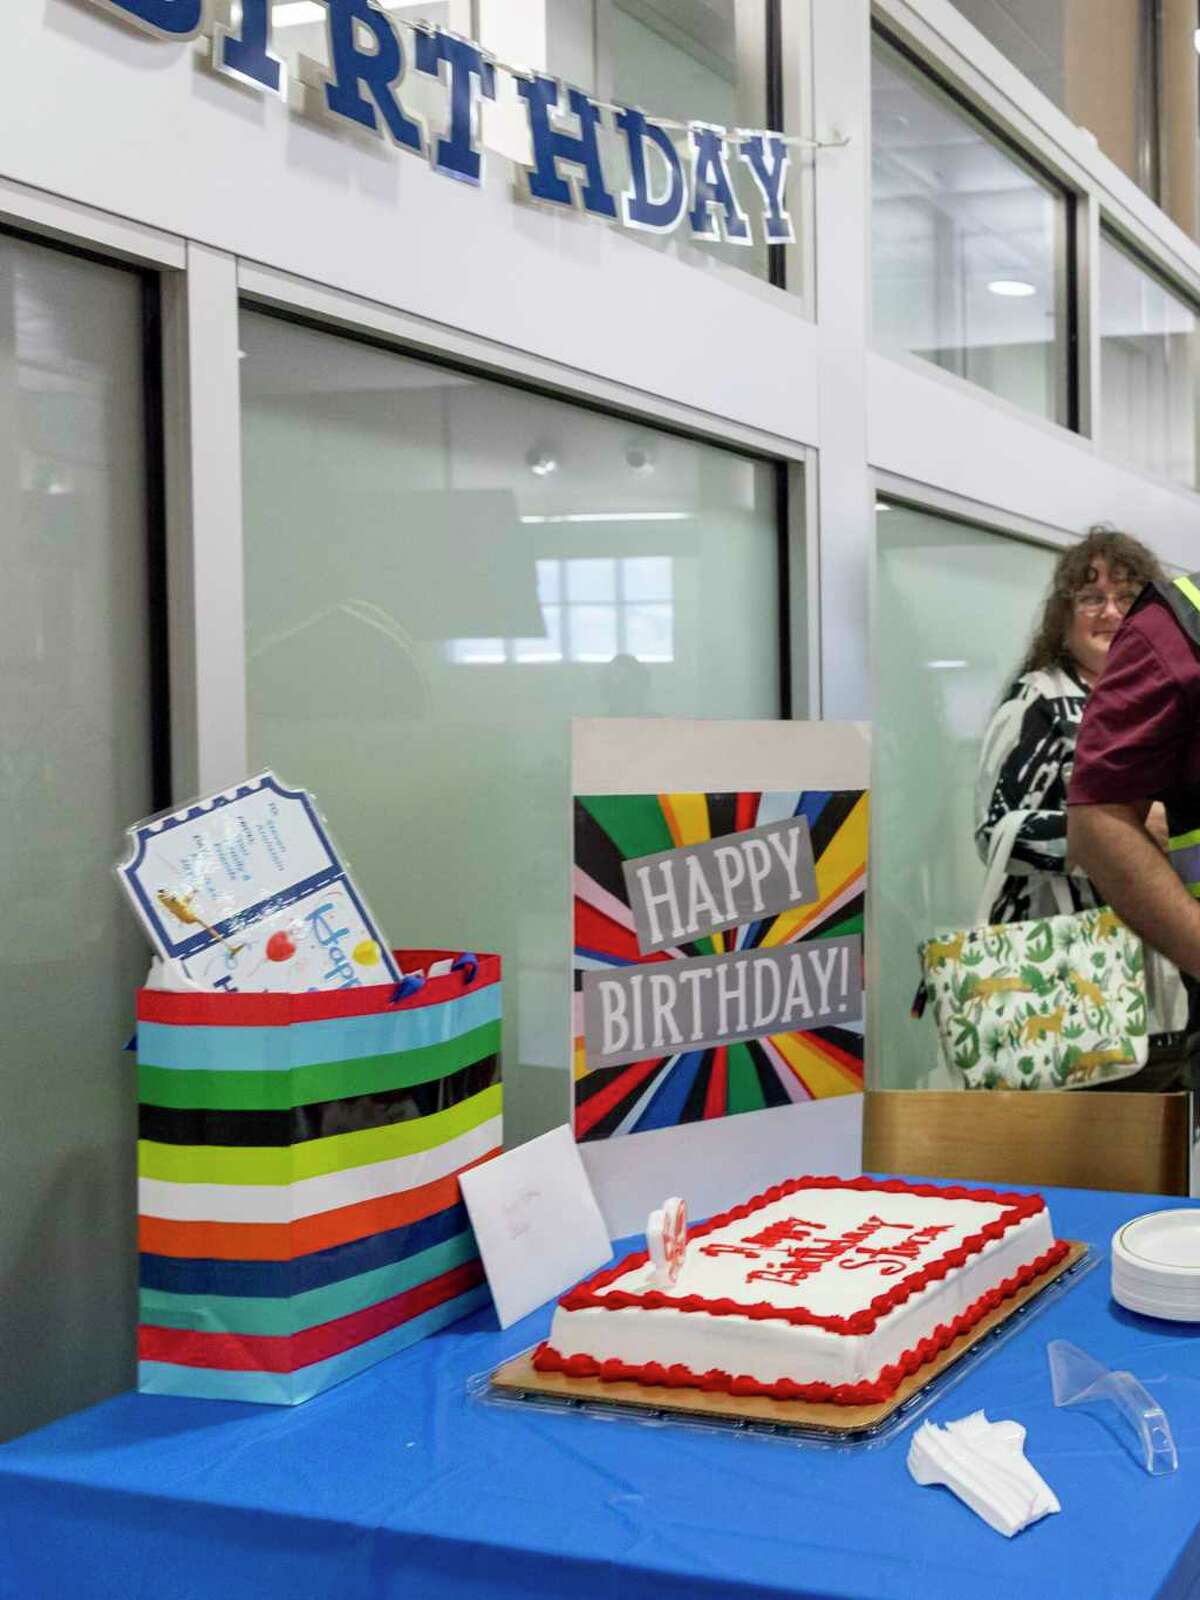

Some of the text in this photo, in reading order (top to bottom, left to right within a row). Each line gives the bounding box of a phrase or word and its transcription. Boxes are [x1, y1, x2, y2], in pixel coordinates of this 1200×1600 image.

[92, 0, 796, 244] IRTHDAY
[636, 826, 802, 944] HAPPY
[599, 946, 849, 1054] BIRTHDAY!
[745, 1215, 915, 1286] Birthday
